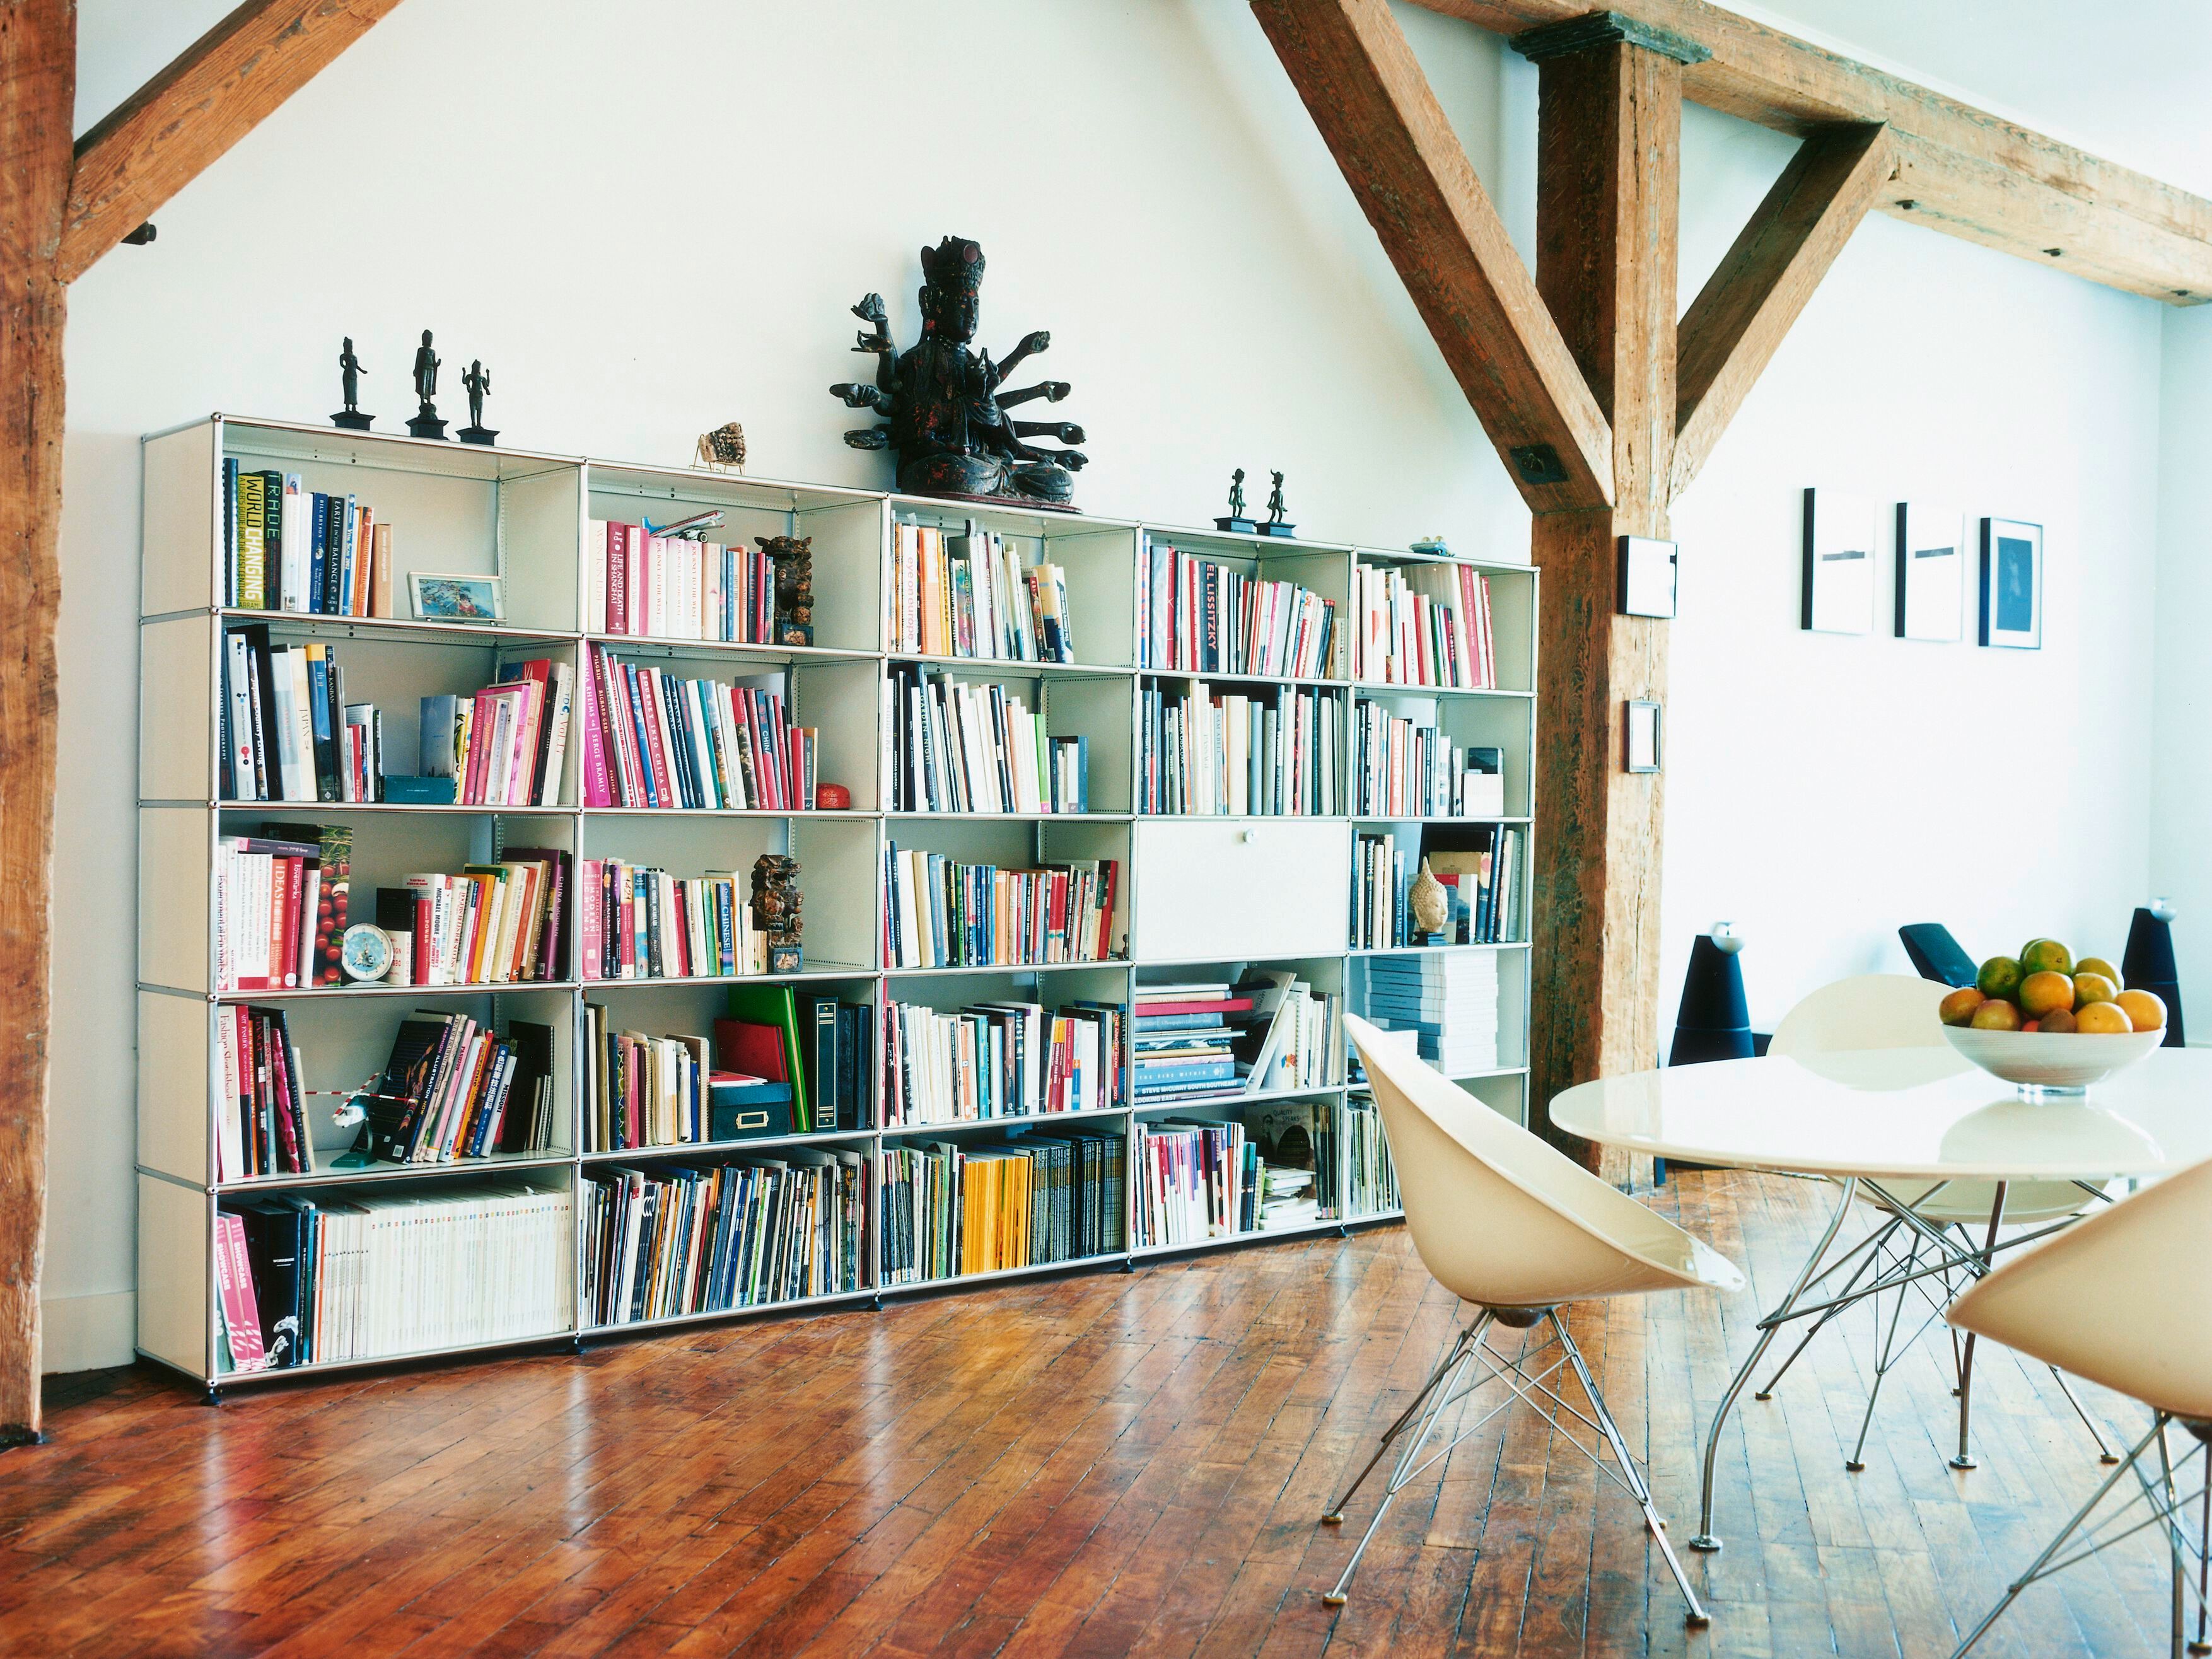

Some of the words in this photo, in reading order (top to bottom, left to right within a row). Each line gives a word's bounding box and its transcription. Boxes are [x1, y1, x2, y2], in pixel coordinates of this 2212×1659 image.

[267, 473, 281, 540] TRADE
[245, 479, 262, 600] WORLDCHANGING
[611, 553, 617, 564] IN
[1207, 564, 1214, 579] EL
[908, 580, 914, 596] on
[907, 598, 915, 641] europe
[1207, 583, 1216, 649] LISSITZKY
[585, 686, 595, 717] RHEIMS
[298, 707, 310, 736] JAPAN
[643, 675, 654, 719] JOURNEY
[651, 725, 659, 748] INTO
[655, 754, 664, 784] CHINA
[592, 734, 602, 759] SERGE
[762, 730, 771, 755] CHINA
[596, 762, 605, 793] BRAMLY
[274, 866, 284, 899] IDEAS
[292, 864, 301, 899] lovemarks
[438, 1026, 449, 1054] FASHION
[455, 1045, 465, 1071] FASHION
[425, 1054, 441, 1099] ILLUSTRATION
[1207, 1080, 1238, 1088] SOUTHEAST
[497, 1084, 509, 1113] MISSONI
[217, 1243, 231, 1291] SHOWCASE
[233, 1242, 247, 1289] SHOWCASE
